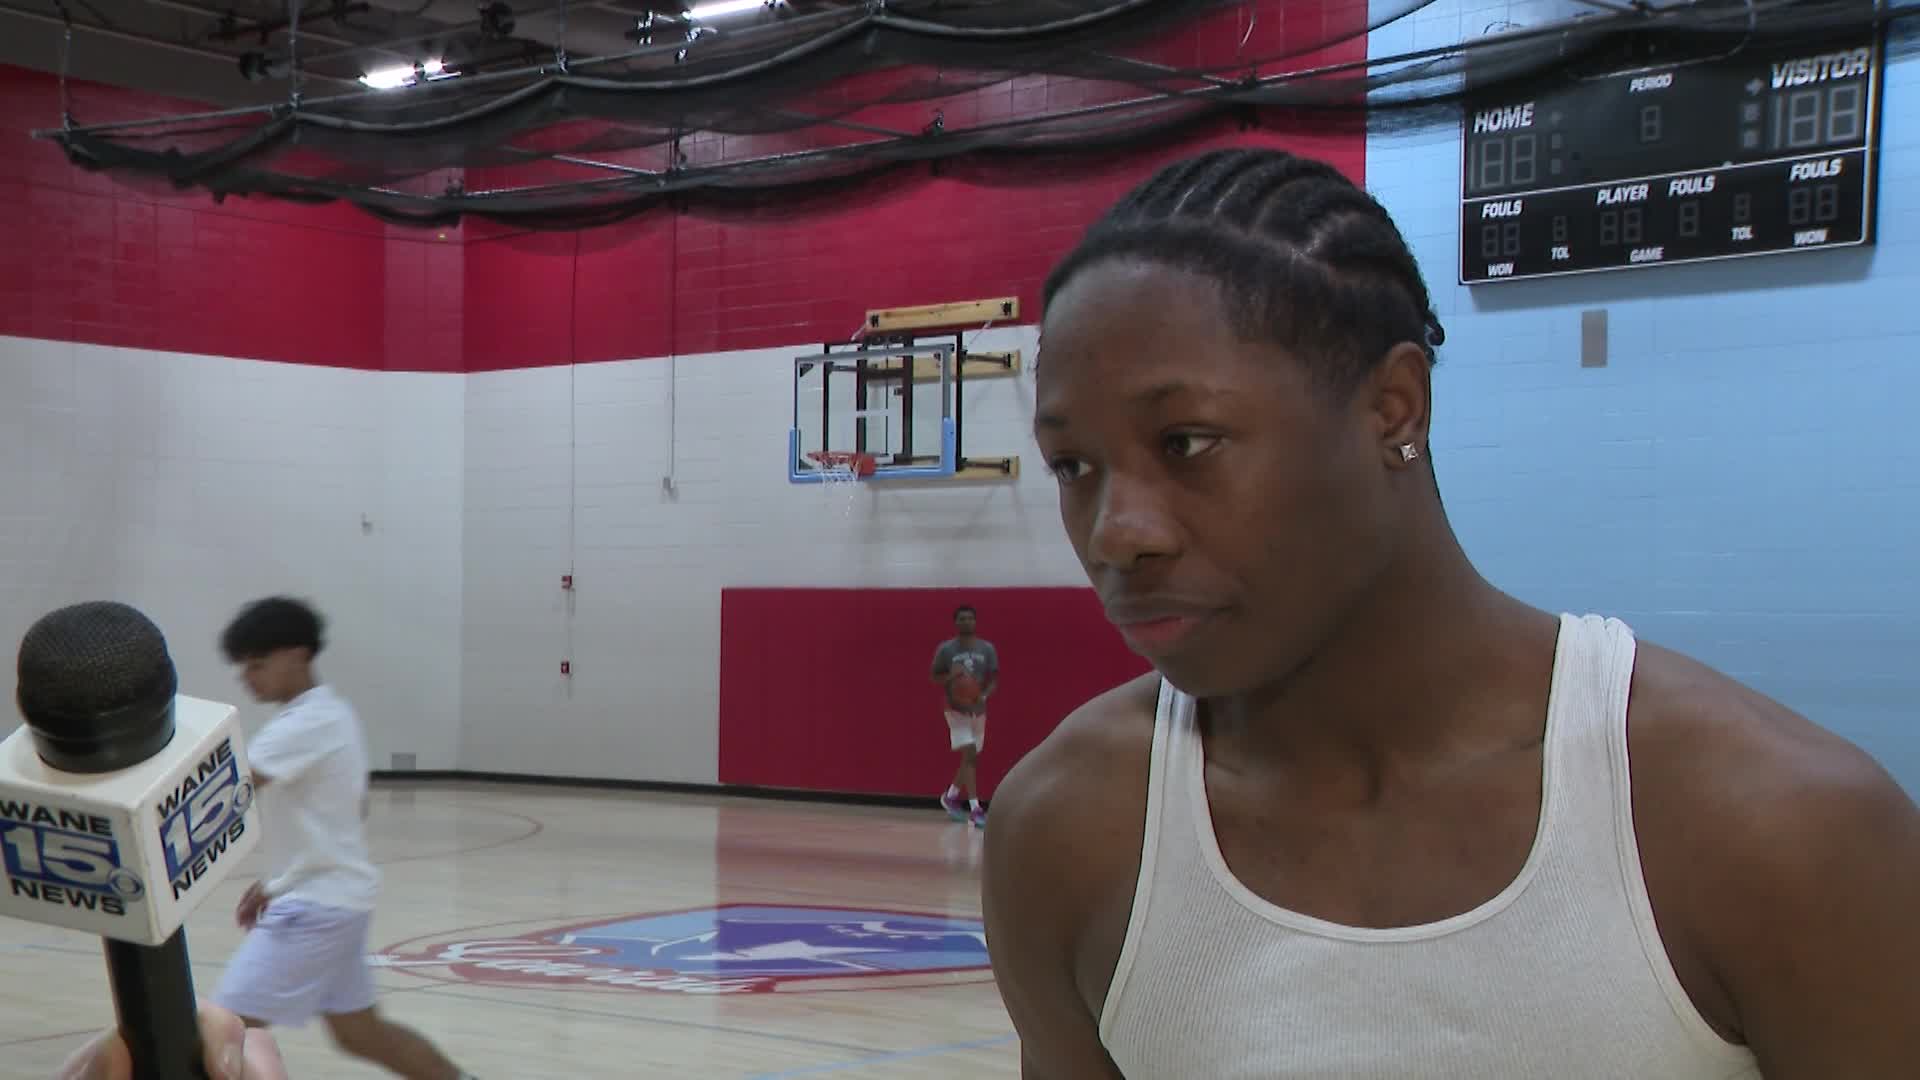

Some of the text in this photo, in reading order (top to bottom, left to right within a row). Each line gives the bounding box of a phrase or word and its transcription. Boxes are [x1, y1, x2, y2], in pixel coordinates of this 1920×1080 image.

[1771, 48, 1869, 89] VISITOR
[1630, 73, 1673, 92] PERIOD
[1474, 102, 1534, 134] HOME
[1790, 158, 1843, 182] FOULS
[1597, 184, 1649, 206] PLAYER
[1668, 175, 1716, 197] FOULS
[1482, 200, 1523, 218] FOULS
[1731, 226, 1753, 240] TOL
[1794, 229, 1828, 246] WON
[1551, 246, 1570, 260] TOL
[1630, 247, 1664, 263] GAME
[1487, 263, 1514, 277] WON
[157, 737, 233, 820] WANE
[0, 800, 113, 837] WANE
[163, 763, 237, 869] 15
[2, 824, 115, 890] 15
[171, 817, 245, 901] NEWS
[11, 878, 126, 917] NEWS
